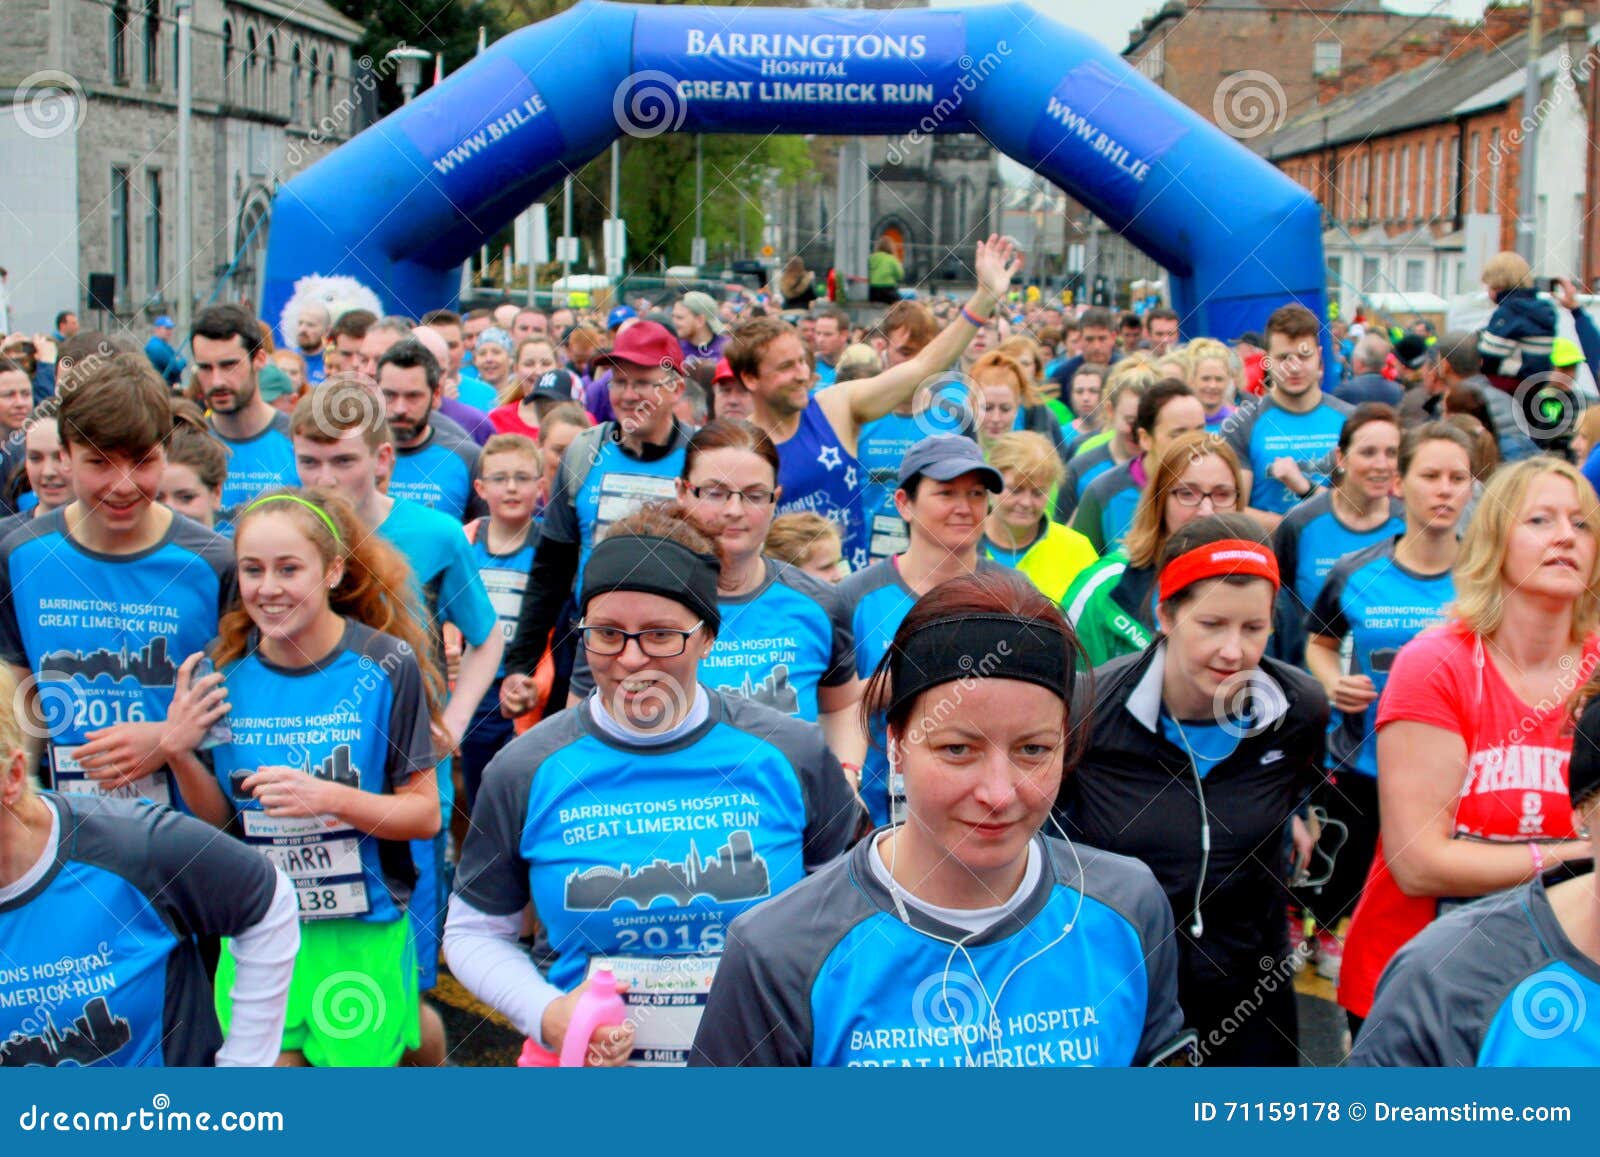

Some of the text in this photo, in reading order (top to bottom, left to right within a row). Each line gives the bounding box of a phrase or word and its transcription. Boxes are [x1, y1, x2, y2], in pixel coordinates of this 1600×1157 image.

[686, 29, 926, 58] BARRINGTONS
[761, 58, 847, 76] HOSPITAL
[677, 80, 934, 102] GREAT LIMERICK RUN
[39, 599, 180, 618] BARRINGTONS HOSPITAL
[38, 614, 178, 634] GREAT LIMERICK RUN
[742, 638, 797, 650] HOSPITAL
[703, 651, 795, 667] LIMERICK RUN
[74, 699, 144, 727] 2016
[232, 733, 262, 745] REAT
[332, 728, 360, 742] RUN
[559, 794, 759, 824] BARRINGTONS HOSPITAL
[562, 811, 760, 846] GREAT LIMERICK RUN
[612, 911, 724, 927] SUNDAY MAY 1ST
[616, 924, 725, 951] 2016
[73, 972, 117, 998] RUN
[850, 1019, 1003, 1051] BARRINGTONS
[654, 1051, 684, 1062] MILE
